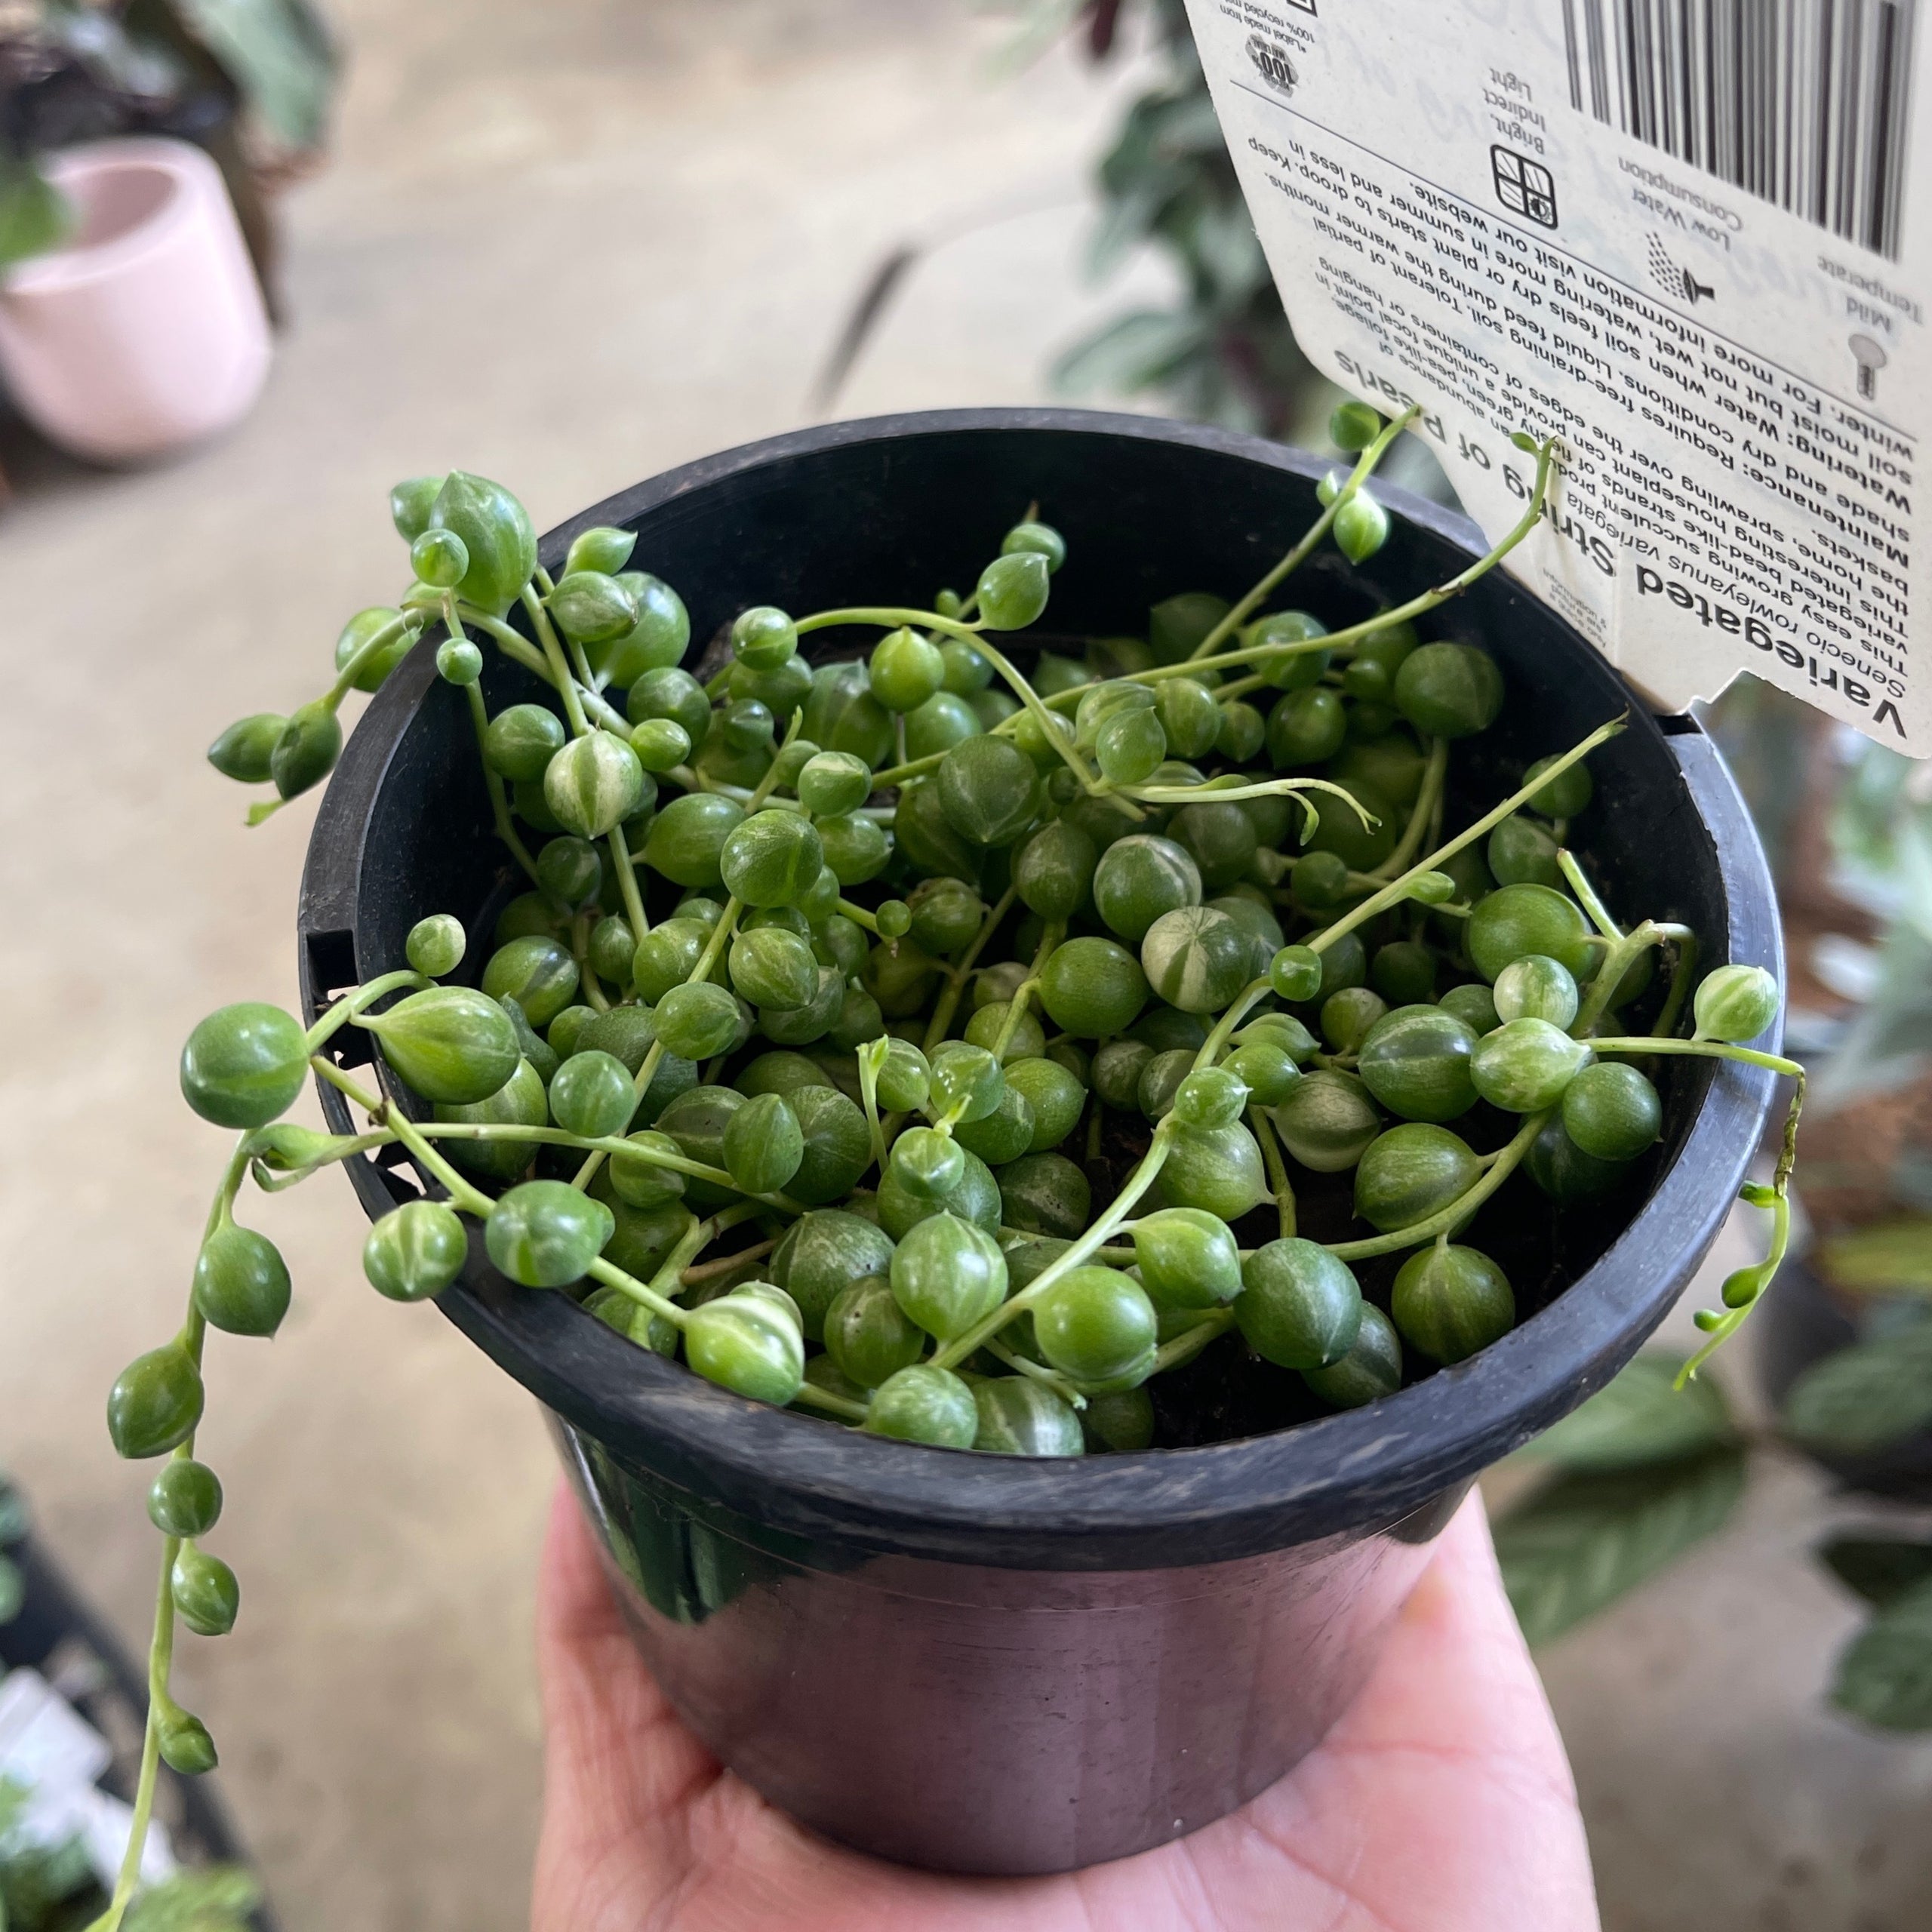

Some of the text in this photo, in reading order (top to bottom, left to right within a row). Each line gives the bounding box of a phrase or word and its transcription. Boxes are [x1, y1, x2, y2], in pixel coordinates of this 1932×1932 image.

[1251, 51, 1297, 85] 100%
[1489, 67, 1532, 103] Light
[1482, 88, 1546, 133] Indirect
[1490, 113, 1545, 155] Bright,
[1618, 156, 1744, 232] Consumption
[1632, 188, 1730, 252] Low Water
[1289, 140, 1912, 485] soil moist but not wet, watering more in summer and less in
[1817, 255, 1923, 325] Temperate
[1846, 295, 1894, 334] Mild
[1248, 137, 1912, 515] Watering: Water when soil feels dry or plant starts to droop. Keep
[1379, 341, 1394, 356] of
[1410, 182, 1913, 461] winter. For more information visit our website.
[1265, 173, 1909, 543] shade and dry conditions. Liquid feed during the warmer months.
[1393, 335, 1458, 384] pea-like
[1398, 354, 1485, 419] abundance
[1312, 217, 1909, 569] Maintenance: Requires free-draining soil. Tolerant of partial
[1462, 378, 1514, 422] green,
[1315, 271, 1909, 638] This interesting houseplant can provide a unique focal point in
[1318, 257, 1909, 617] the home, sprawling over the edges of containers or hanging
[1459, 432, 1491, 470] of
[1490, 417, 1512, 440] an
[1520, 418, 1573, 463] fleshy
[1578, 457, 1595, 475] of
[1601, 473, 1676, 522] strands
[1601, 494, 1700, 555] succulent
[1683, 519, 1782, 585] bead-like
[1708, 550, 1793, 606] growing
[1811, 529, 1909, 597] baskets.
[1567, 491, 1906, 698] Senecio rowleyanus variegata
[1790, 578, 1908, 655] variegated
[1801, 604, 1852, 640] easy
[1636, 564, 1907, 740] Variegated
[1860, 639, 1908, 678] This
